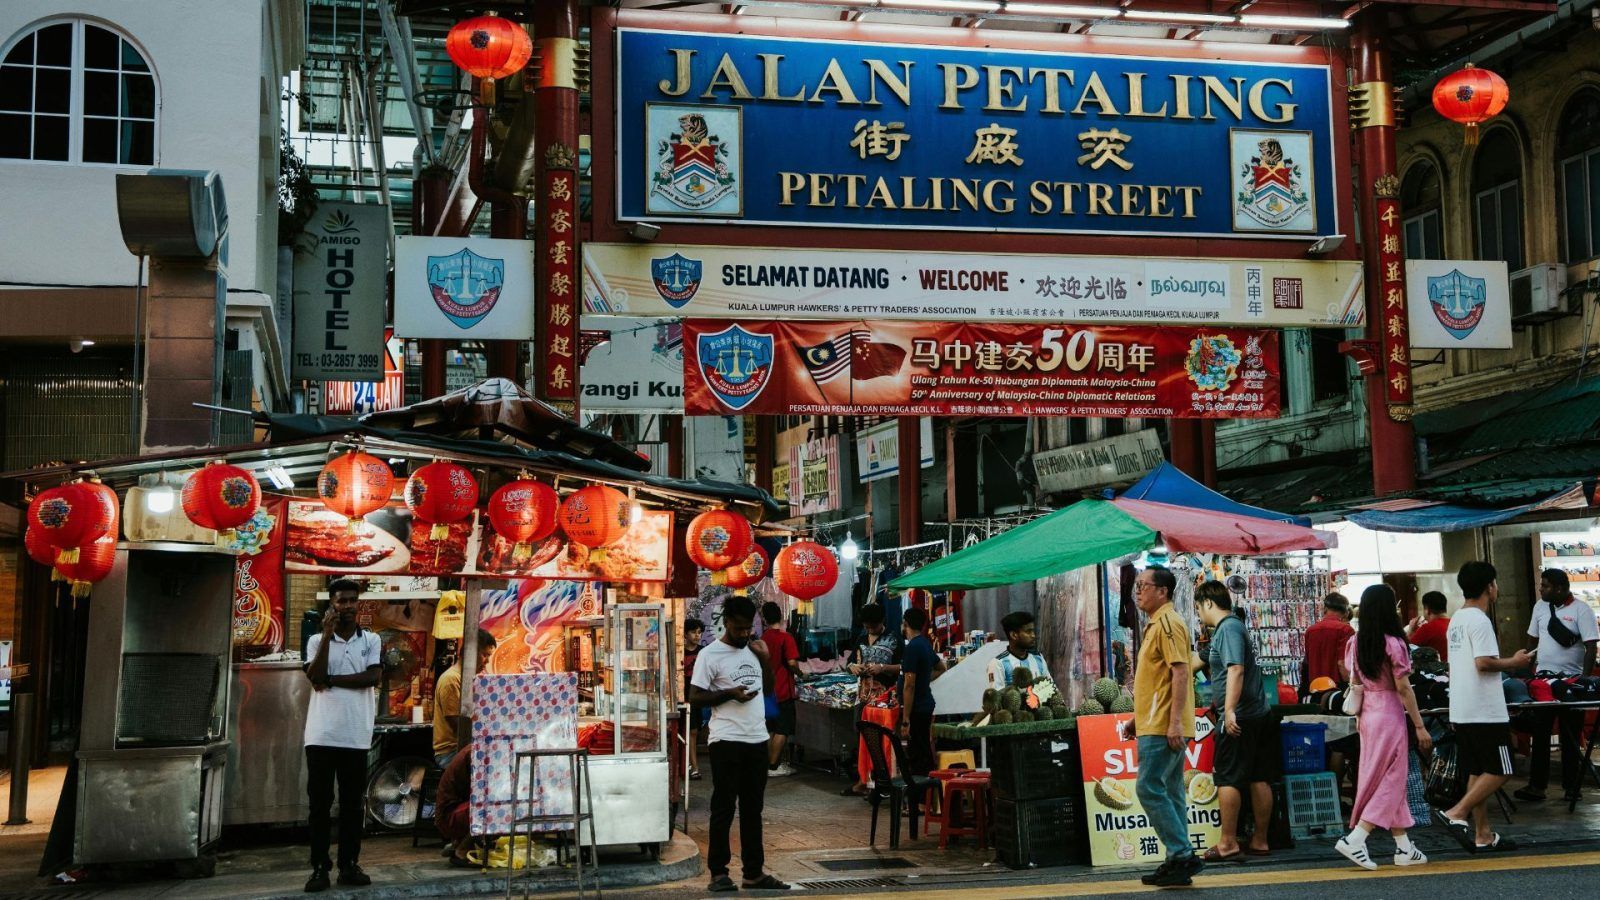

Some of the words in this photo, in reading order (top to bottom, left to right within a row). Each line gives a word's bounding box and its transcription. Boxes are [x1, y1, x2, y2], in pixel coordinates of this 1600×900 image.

[658, 48, 915, 107] JALAN
[937, 62, 1299, 124] PETALING
[778, 172, 1017, 215] PETALING
[1030, 180, 1203, 219] STREET
[320, 236, 361, 246] AMIGO
[722, 264, 809, 288] SELAMAT
[813, 267, 890, 289] DATANG
[918, 269, 1009, 292] WELCOME
[1035, 274, 1128, 301] 欢迎光临
[1151, 275, 1226, 297] நல்வரவு
[1245, 268, 1263, 317] 丙申年
[324, 248, 355, 351] HOTEL
[728, 303, 758, 311] KUALA
[760, 303, 795, 312] LUMPUR
[797, 304, 842, 313] HAWKERS'
[843, 304, 850, 312] &
[851, 304, 878, 313] PETTY
[922, 306, 977, 315] ASSOCIATION
[1079, 308, 1109, 318] PERSATUAN
[1110, 309, 1132, 318] PENJAJA
[1132, 309, 1144, 318] DAN
[1144, 310, 1166, 319] PENIAGA
[1166, 310, 1181, 319] KECIL
[1182, 311, 1198, 319] KUALA
[1199, 311, 1220, 319] LUMPUR
[321, 353, 356, 368] 03-2857
[357, 354, 379, 368] 3999
[648, 382, 685, 397] Ku
[911, 375, 937, 387] Ulang
[940, 375, 967, 385] Tahun
[969, 376, 993, 386] Ke-50
[995, 377, 1039, 388] Hubungan
[1041, 377, 1089, 389] Diplomatik
[1090, 378, 1157, 390] Malaysia-China
[327, 381, 352, 411] BUKA
[353, 381, 375, 413] 24
[376, 376, 401, 411] JAM
[930, 390, 984, 402] Anniversary
[985, 390, 996, 402] of
[997, 391, 1065, 402] Malaysia-China
[1066, 391, 1113, 403] Diplomatic
[1114, 391, 1156, 402] Relations
[789, 404, 831, 414] PERSATUAN
[831, 405, 861, 414] PENJAJA
[863, 405, 878, 414] DAN
[879, 405, 909, 414] PENIAGA
[910, 405, 929, 414] KECIL
[930, 405, 943, 414] K.L.
[1035, 406, 1069, 416] HAWKERS'
[1071, 407, 1077, 415] &
[1077, 407, 1097, 416] PETTY
[1097, 407, 1128, 416] TRADERS'
[1130, 407, 1174, 417] ASSOCIATION
